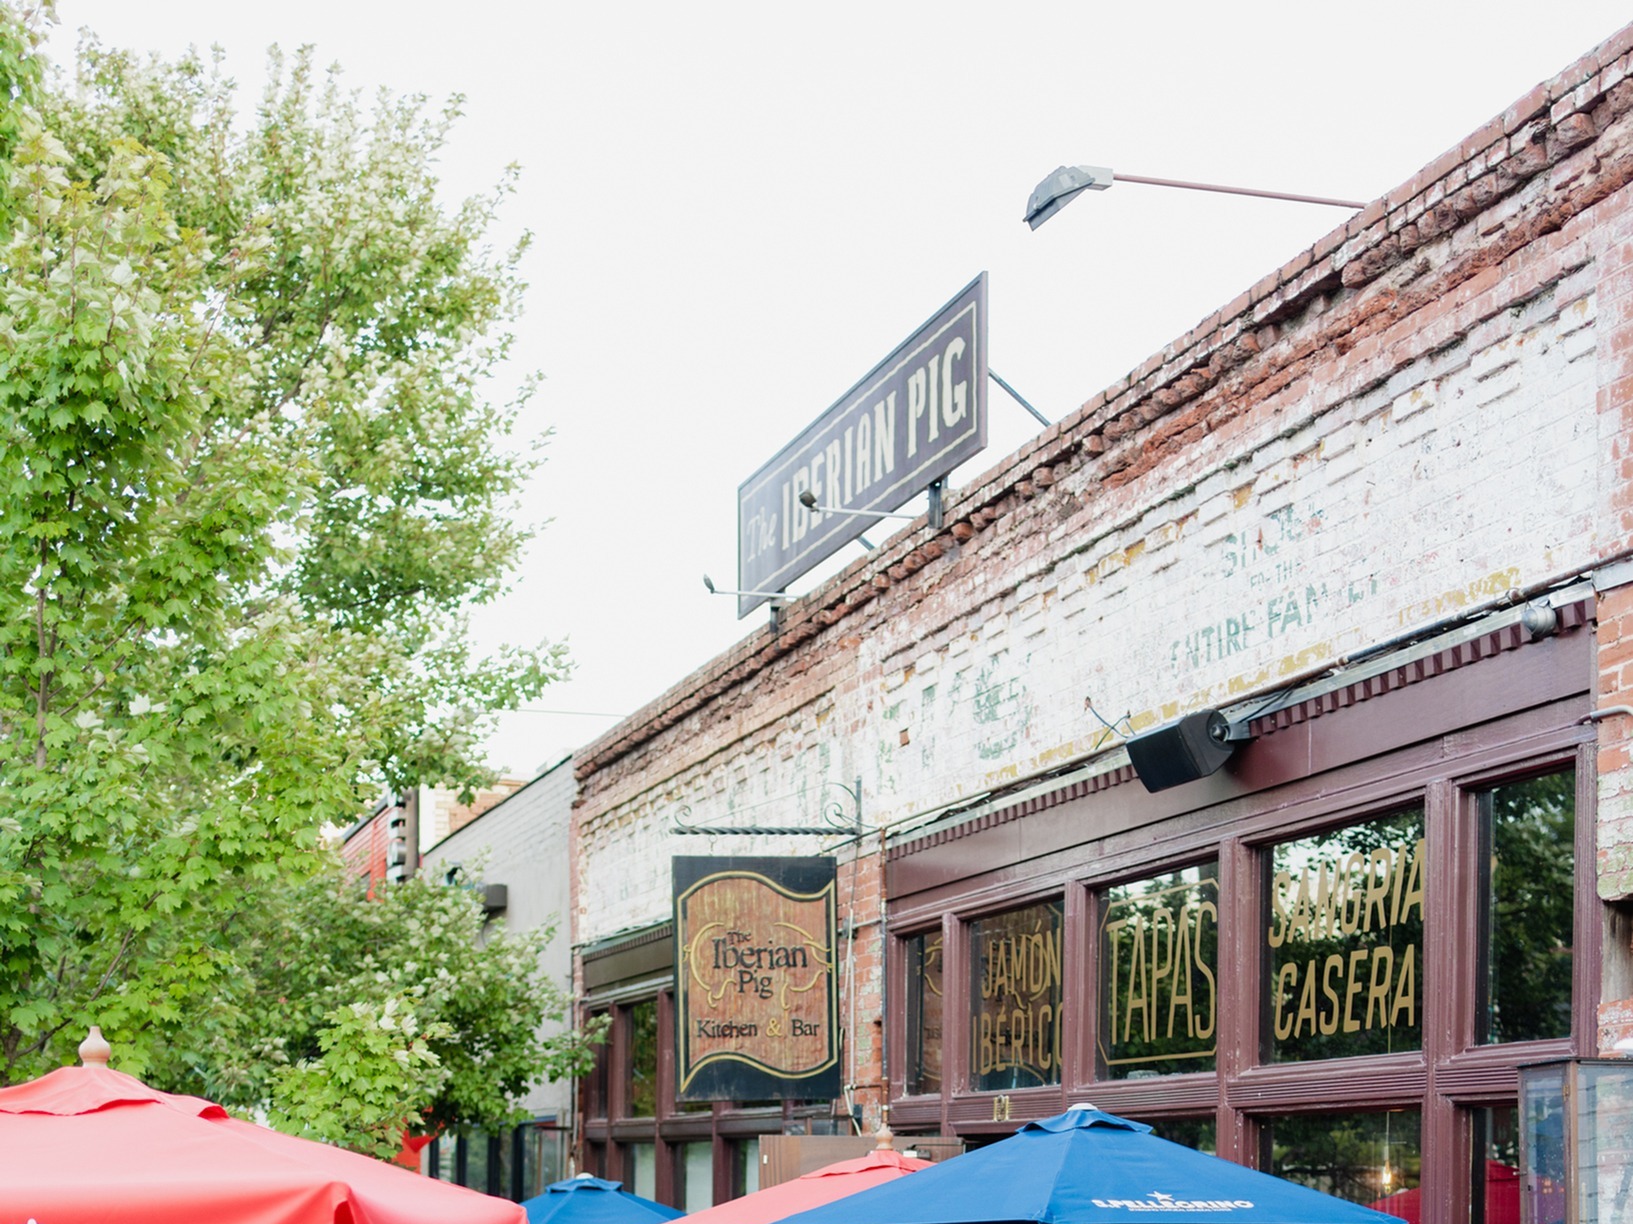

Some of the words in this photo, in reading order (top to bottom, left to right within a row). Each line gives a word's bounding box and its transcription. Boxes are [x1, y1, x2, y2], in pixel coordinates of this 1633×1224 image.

[747, 506, 777, 562] The
[781, 390, 897, 550] IBERIAN
[907, 336, 967, 458] PIG
[1268, 838, 1425, 948] SANGRIA
[711, 938, 809, 969] Iberian
[726, 930, 752, 945] The
[981, 919, 1062, 999] JAMÓN
[1106, 900, 1218, 1046] TAPAS
[737, 969, 774, 999] Pig
[1274, 943, 1415, 1041] CASERA
[696, 1019, 759, 1039] Kitchen
[766, 1017, 783, 1037] &
[791, 1018, 821, 1037] Bar
